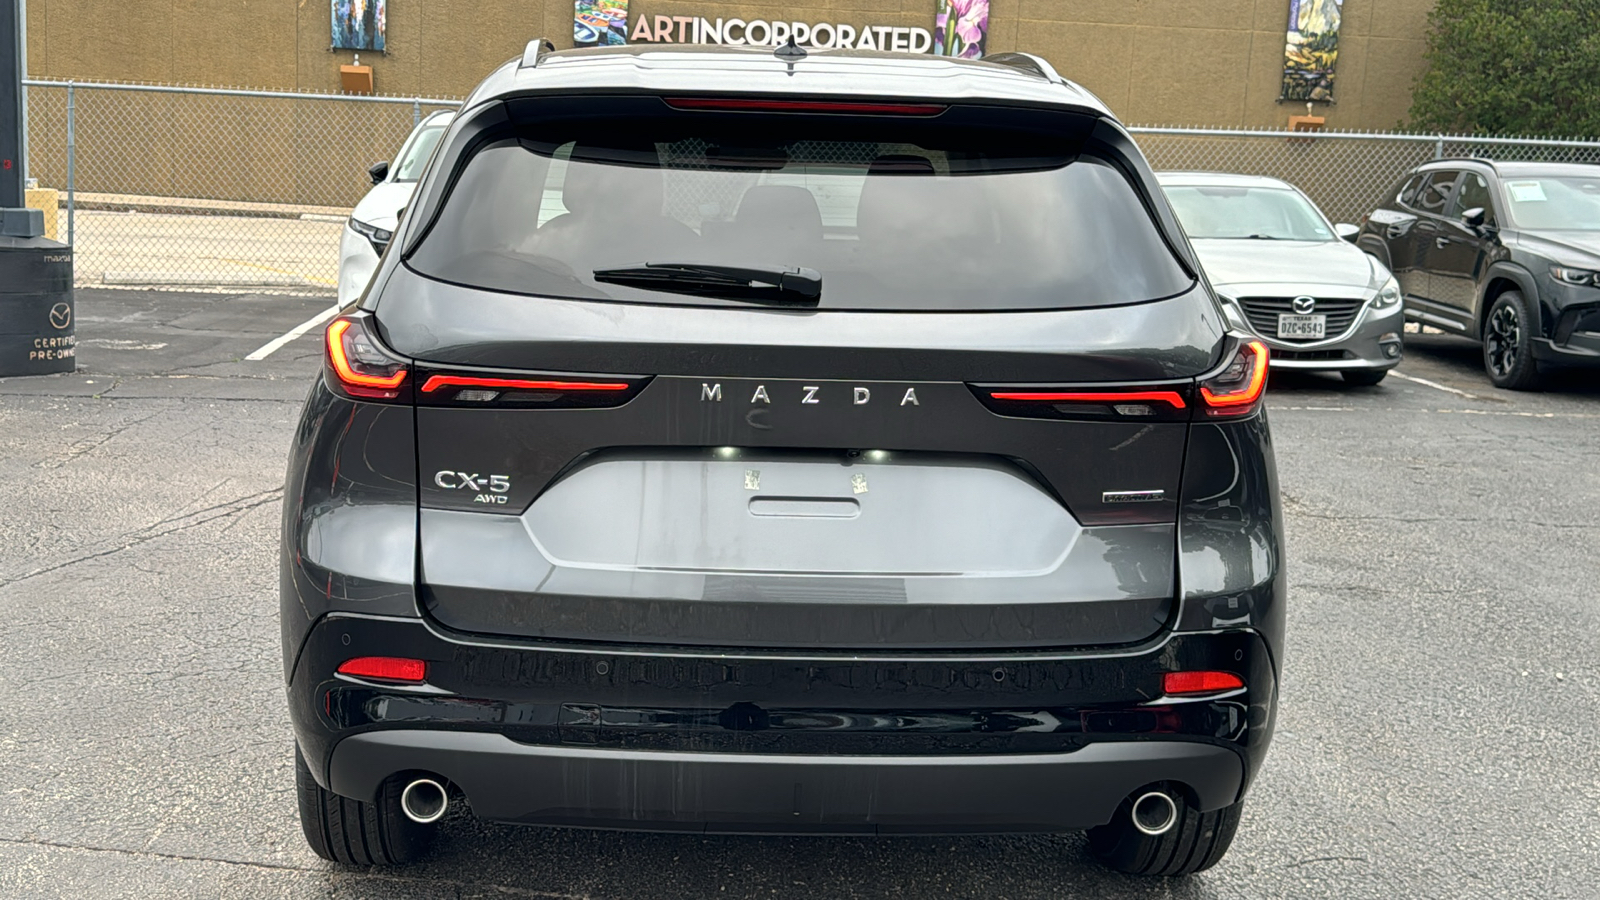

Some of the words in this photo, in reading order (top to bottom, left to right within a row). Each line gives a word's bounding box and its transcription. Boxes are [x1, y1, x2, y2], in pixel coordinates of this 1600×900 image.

[29, 347, 75, 360] PRE-OWNE
[701, 383, 920, 406] MAZDA
[434, 470, 510, 493] CX-5
[473, 494, 508, 504] AWD
